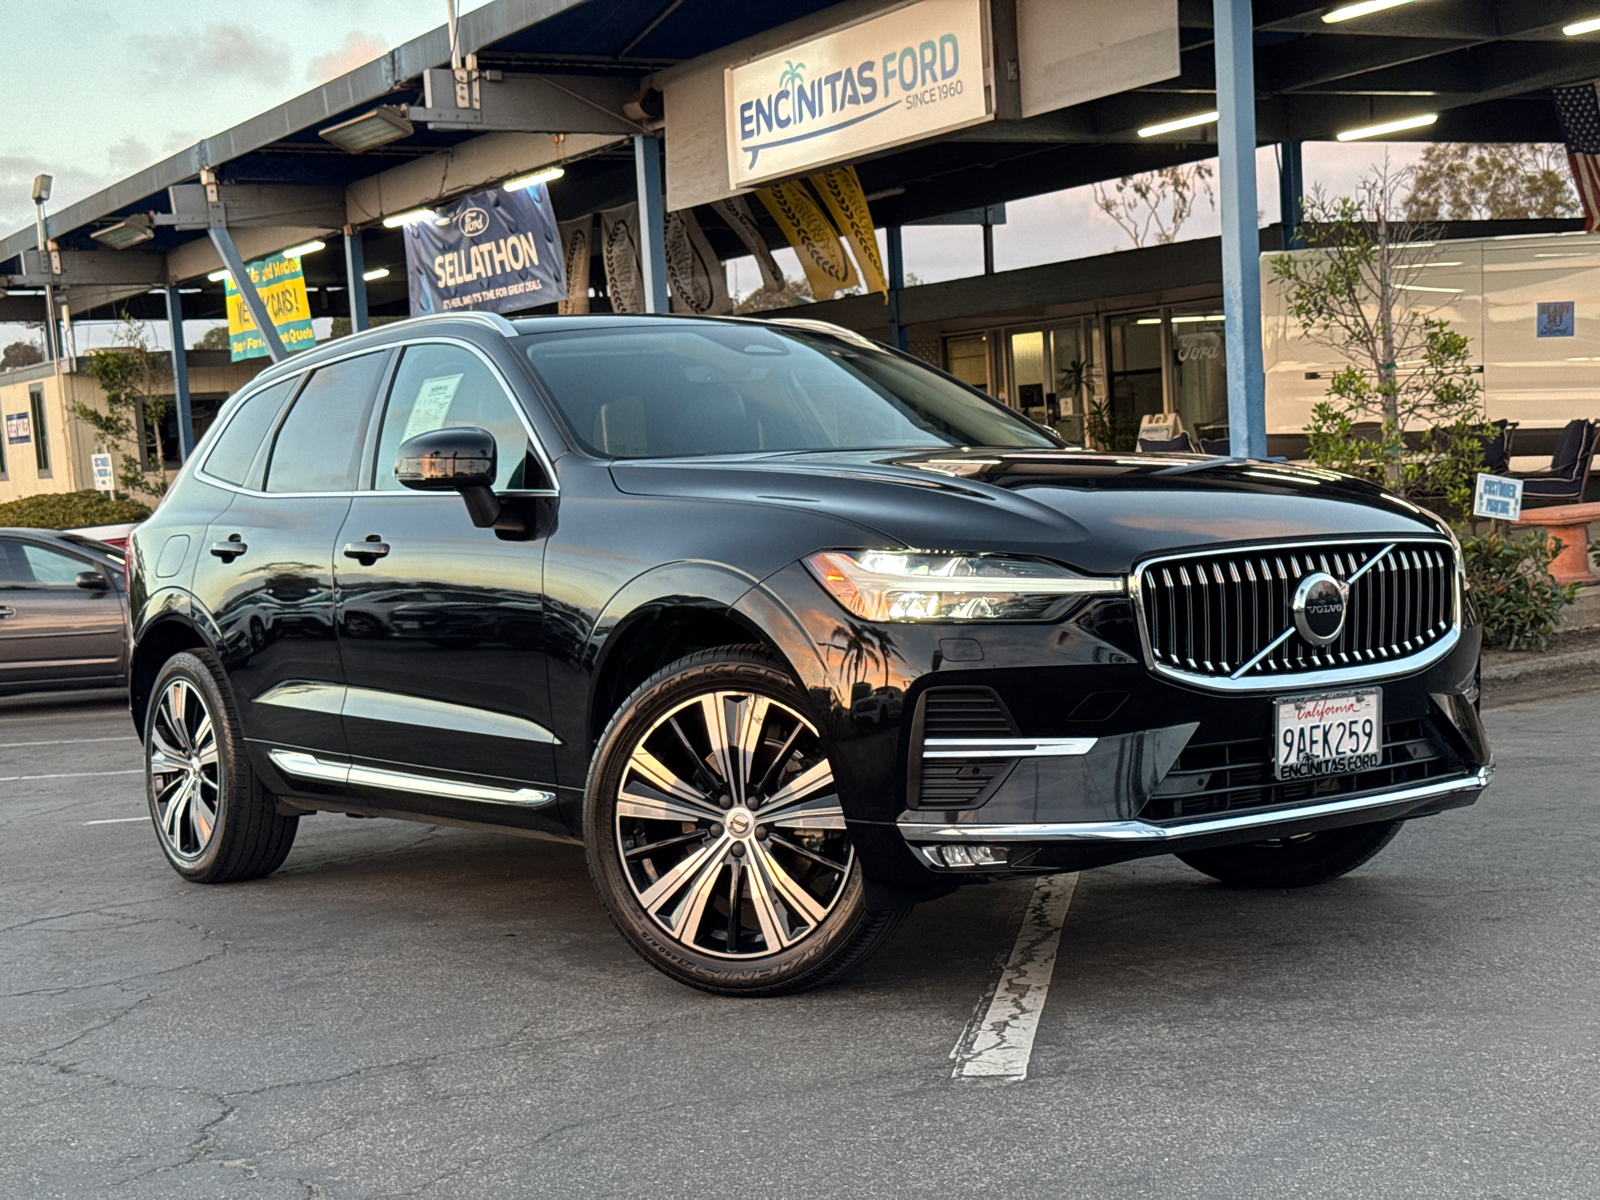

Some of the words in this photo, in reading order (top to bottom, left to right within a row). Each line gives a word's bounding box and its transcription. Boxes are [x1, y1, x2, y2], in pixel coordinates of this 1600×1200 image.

[739, 60, 878, 142] ENCINITAS
[882, 33, 960, 99] FORD
[905, 88, 937, 110] SINCE
[937, 80, 964, 101] 1960
[463, 211, 485, 233] Ford
[434, 231, 540, 289] SELLATHON
[481, 290, 496, 301] TIME
[495, 287, 508, 298] FOR
[507, 283, 525, 295] GREAT
[1540, 304, 1570, 315] READY
[1547, 314, 1563, 325] SET
[289, 327, 314, 344] Quote
[1540, 324, 1569, 336] Ford
[1177, 332, 1221, 362] Ford
[1306, 603, 1343, 615] VOLVO
[1296, 699, 1362, 723] California
[1282, 718, 1374, 764] 9AEK259
[1280, 757, 1346, 780] ENCINITAS
[1347, 753, 1378, 772] FORD
[694, 928, 834, 984] AZENIS
